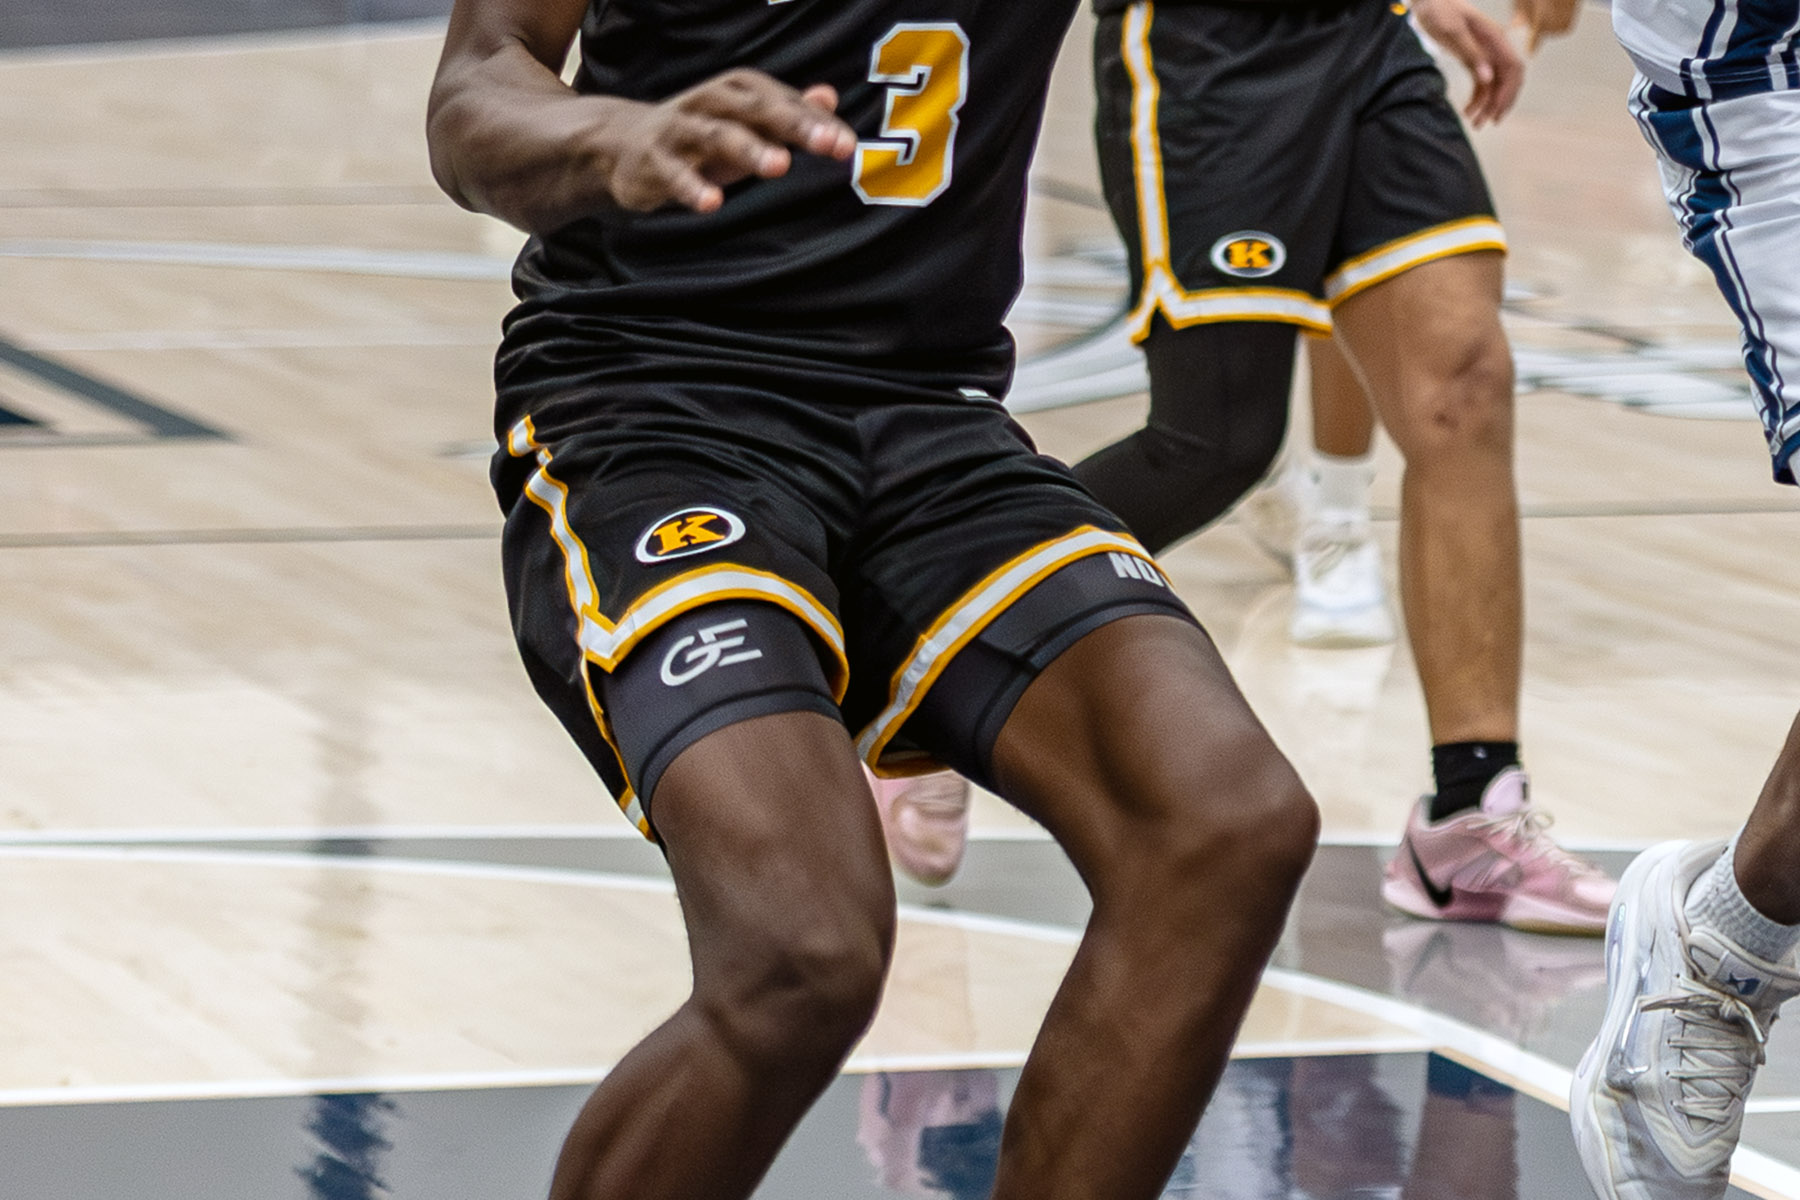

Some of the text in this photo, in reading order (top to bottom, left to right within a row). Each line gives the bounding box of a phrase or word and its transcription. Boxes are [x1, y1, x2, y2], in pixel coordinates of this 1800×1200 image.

[851, 22, 971, 207] 3
[1228, 241, 1274, 270] K
[652, 511, 725, 555] K
[660, 618, 763, 687] GE
